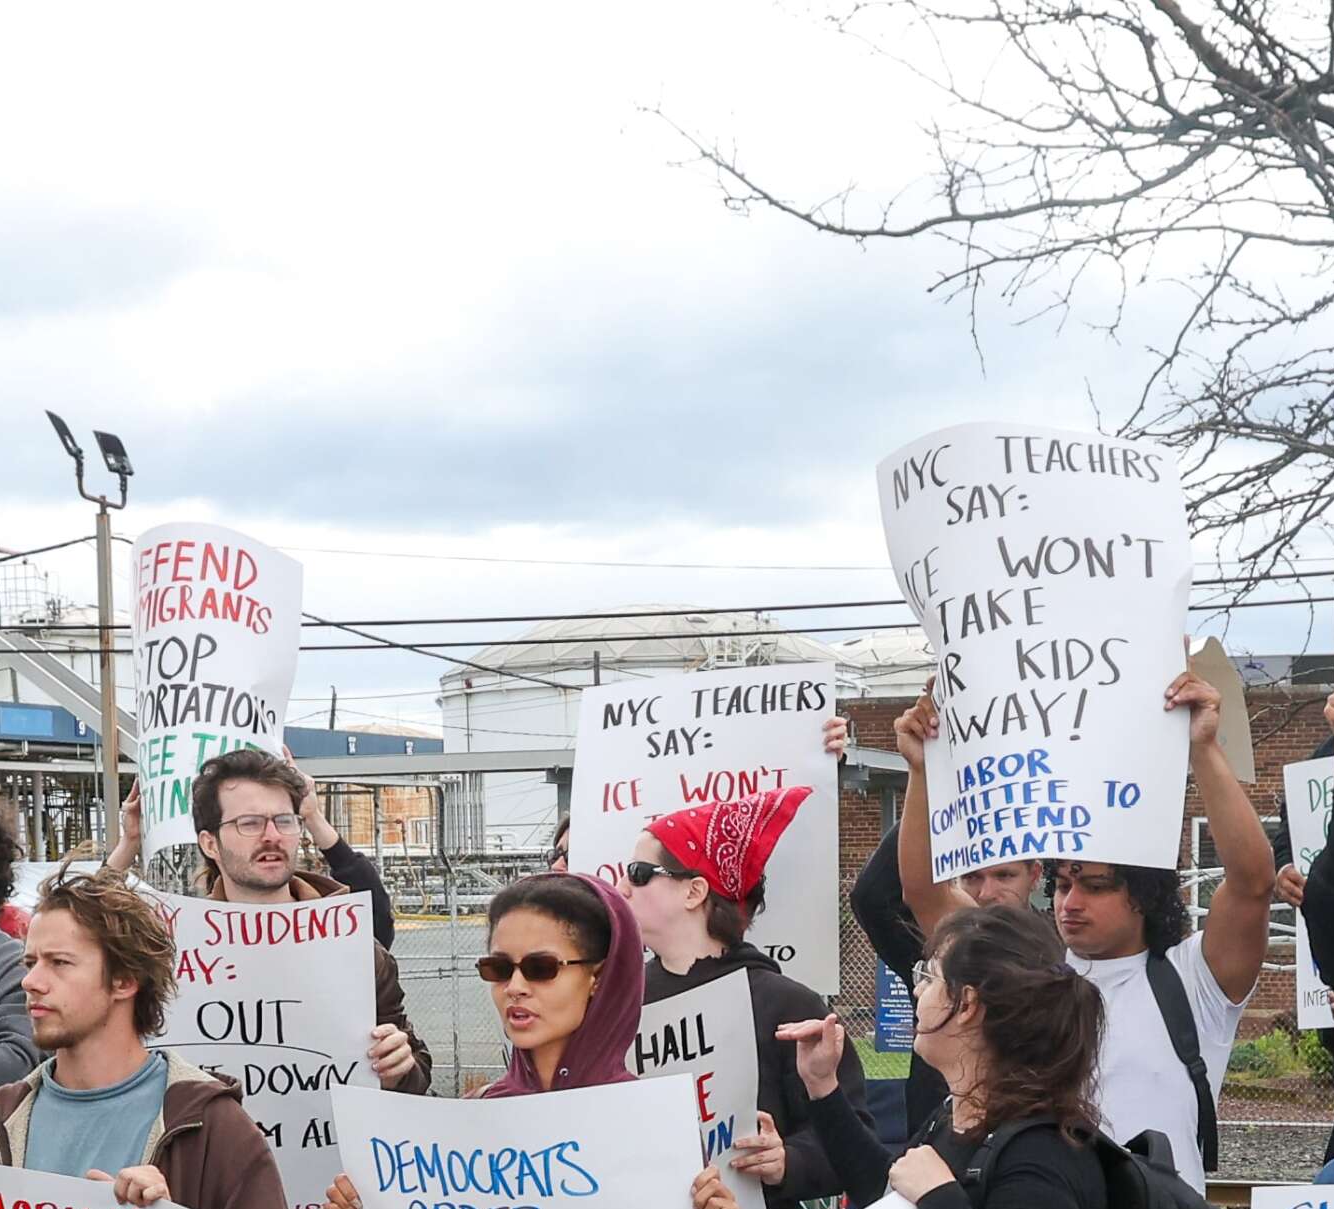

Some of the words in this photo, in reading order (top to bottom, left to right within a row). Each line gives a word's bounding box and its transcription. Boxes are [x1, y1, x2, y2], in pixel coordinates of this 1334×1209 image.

[892, 444, 953, 510] NYC
[995, 435, 1163, 483] TEACHERS
[947, 483, 1030, 526] SAY:
[138, 541, 258, 590] EFEND
[903, 546, 939, 616] ICE
[997, 534, 1164, 579] WON'T
[935, 587, 1045, 645] TAKE
[139, 633, 218, 685] TOP
[1016, 638, 1129, 686] KIDS
[603, 696, 663, 730] NYC
[691, 680, 827, 719] TEACHERS
[946, 688, 1088, 757] AWAY!
[139, 735, 178, 783] REE
[647, 726, 714, 759] SAY:
[602, 777, 644, 813] ICE
[679, 765, 789, 804] WON'T
[957, 748, 1051, 793] LABOR
[932, 779, 1069, 836] COMMITTEE
[1103, 780, 1141, 809] TO
[967, 805, 1091, 841] DEFEND
[935, 830, 1091, 876] IMMIGRANTS
[205, 904, 364, 946] STUDENTS
[176, 948, 237, 984] AY:
[765, 944, 796, 962] TO
[197, 999, 302, 1045] OUT
[635, 1012, 715, 1076] HALL
[244, 1061, 358, 1096] DOWN
[302, 1118, 338, 1149] AL
[371, 1137, 599, 1197] DEMOCRATS
